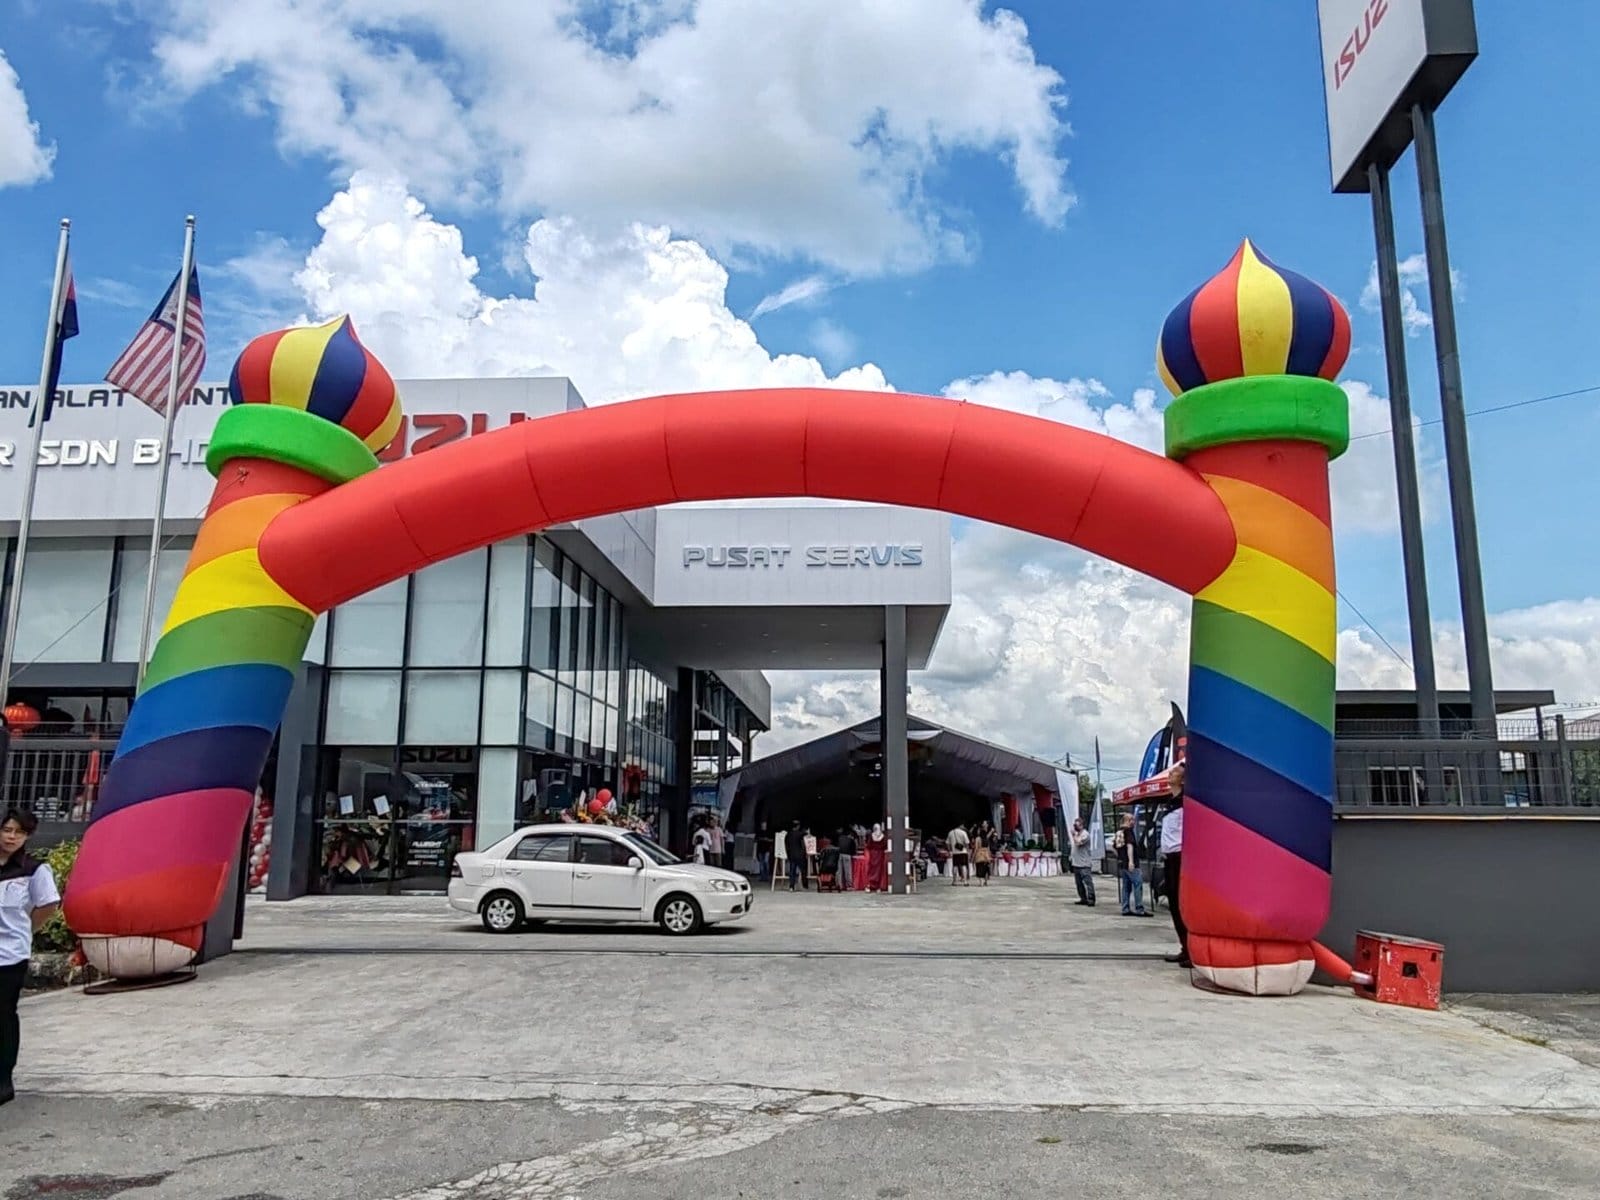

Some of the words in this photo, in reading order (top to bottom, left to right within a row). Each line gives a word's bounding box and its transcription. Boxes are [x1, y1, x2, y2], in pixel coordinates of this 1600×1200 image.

[37, 439, 119, 466] SDN
[683, 545, 791, 568] PUSAT
[806, 545, 923, 567] SERVIS
